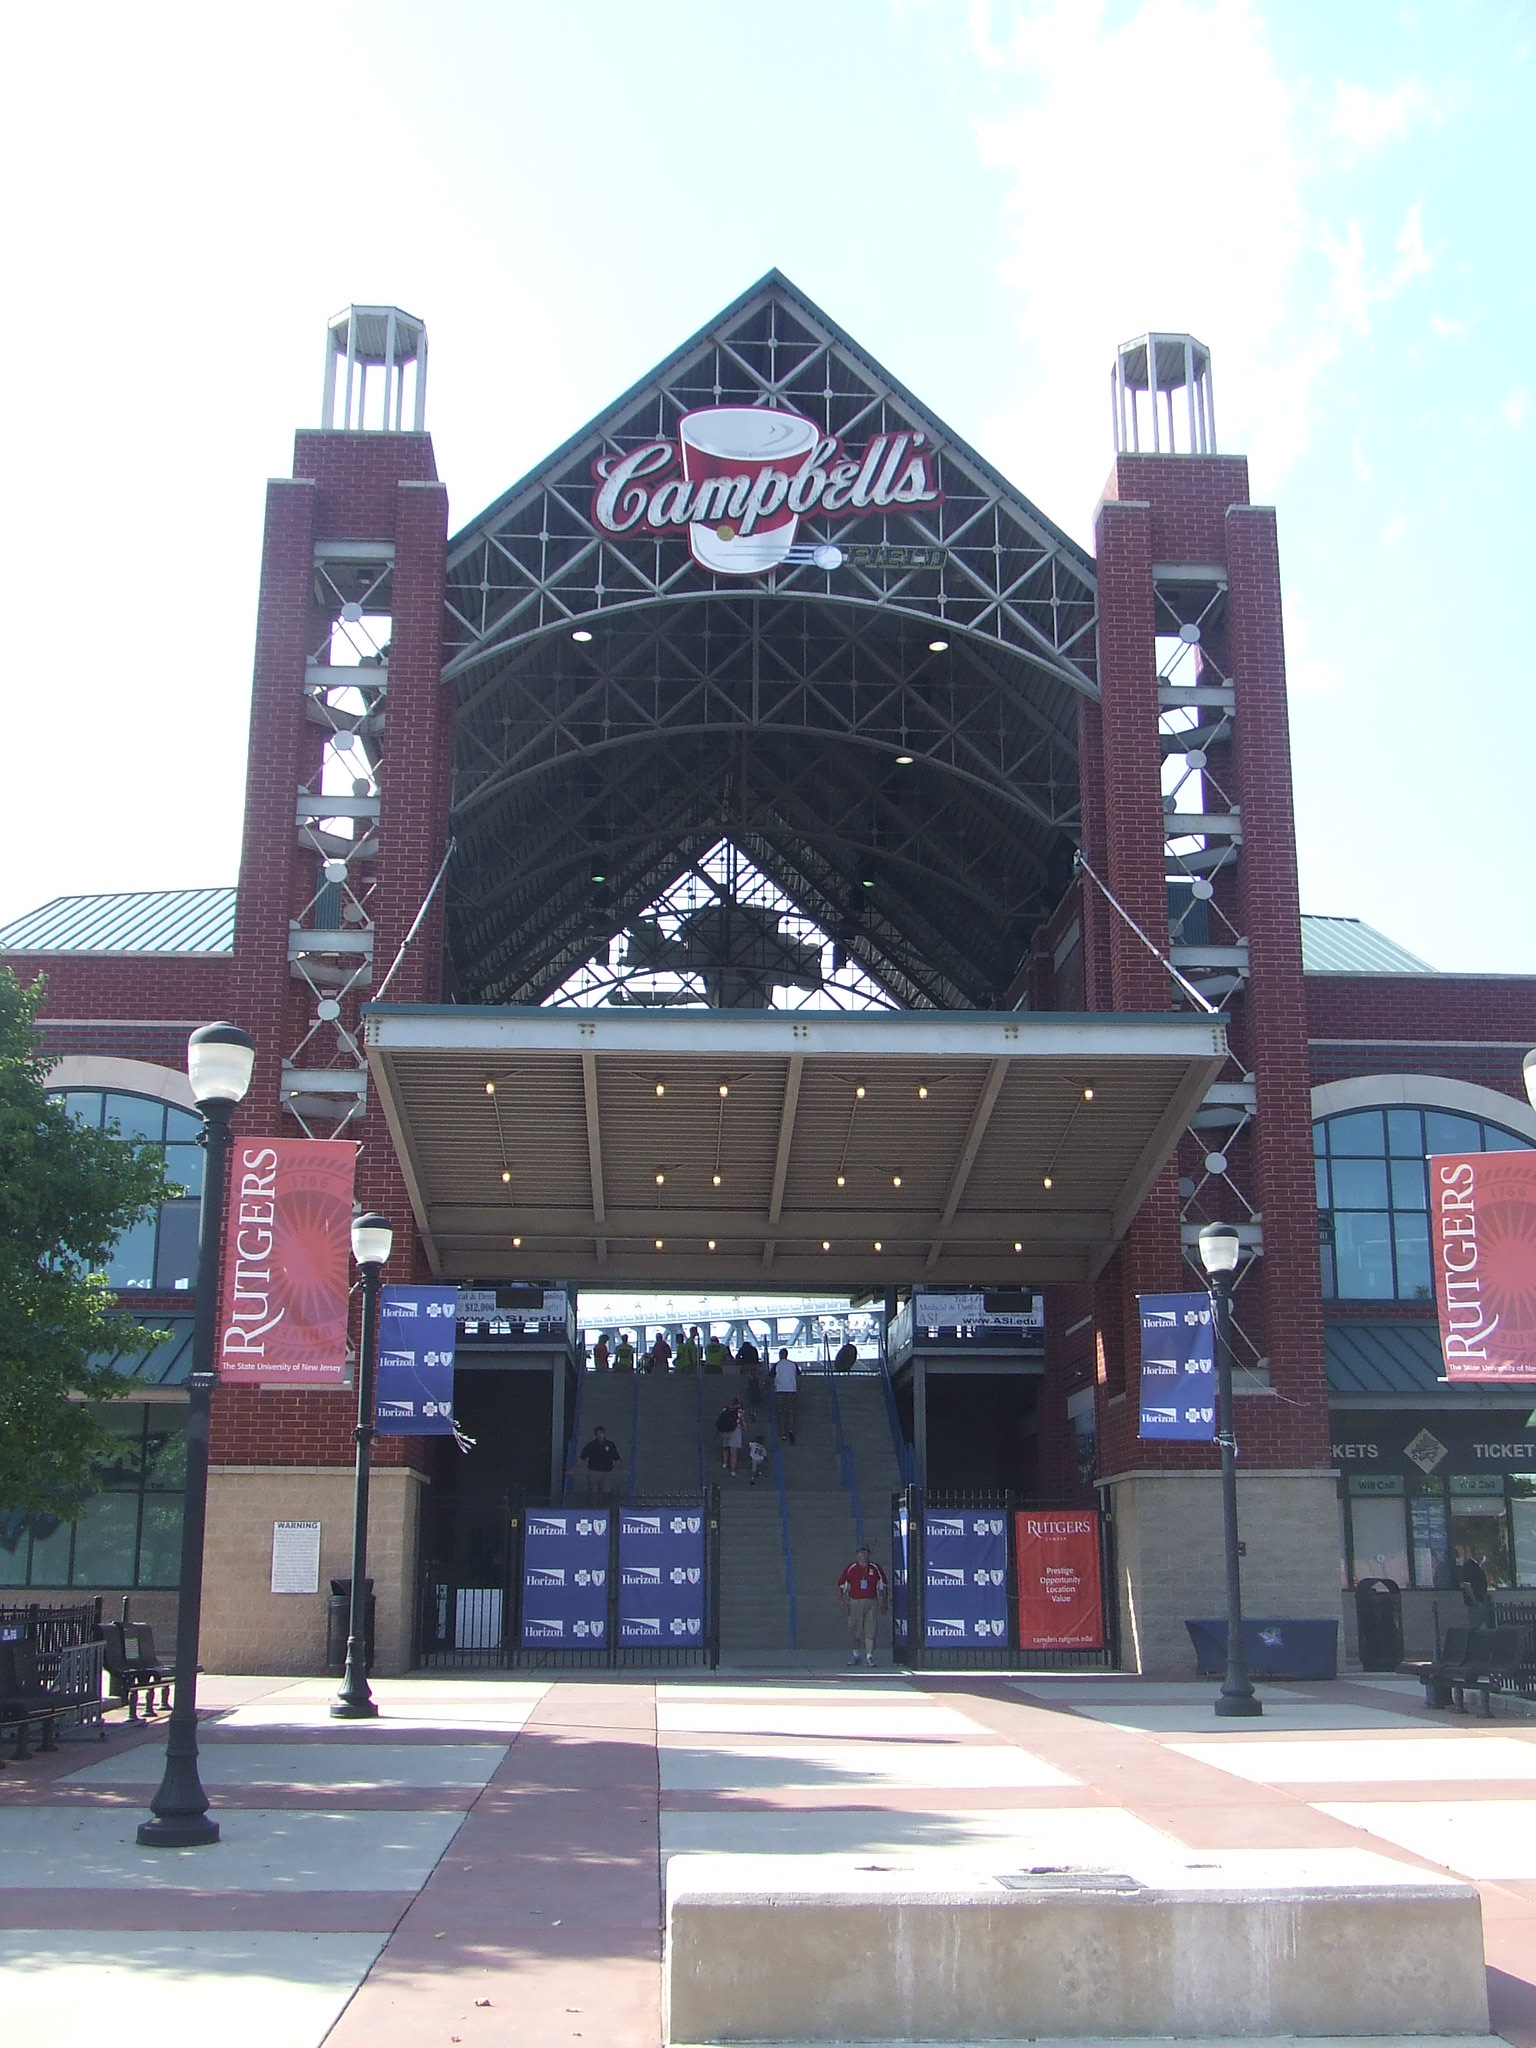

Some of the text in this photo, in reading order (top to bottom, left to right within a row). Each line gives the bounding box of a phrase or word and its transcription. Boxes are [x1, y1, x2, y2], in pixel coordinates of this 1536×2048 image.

[595, 432, 938, 537] Campbell's
[847, 546, 949, 569] FIELD
[222, 1148, 285, 1358] RUTGERS
[1441, 1163, 1499, 1361] RUTGERS
[382, 1308, 418, 1317] Horizon
[962, 1316, 1038, 1325] www.ASI.edu
[1143, 1318, 1177, 1328] Horizon
[223, 1362, 341, 1373] The State University of New Jersey
[379, 1357, 415, 1367] Horizon
[1449, 1363, 1461, 1371] The
[1142, 1366, 1177, 1375] Horizon
[378, 1408, 414, 1417] Horizon
[1142, 1414, 1177, 1423] Horizon
[1329, 1443, 1379, 1458] KETS
[1473, 1443, 1536, 1458] TICKET
[1358, 1481, 1395, 1490] Will Call
[528, 1525, 567, 1535] Horizon
[622, 1523, 661, 1534] Horizon
[926, 1525, 964, 1536] Horizon
[1027, 1520, 1091, 1539] RUTGERS
[1046, 1567, 1074, 1576] Prestige
[526, 1575, 565, 1586] Horizon
[622, 1574, 661, 1585] Horizon
[926, 1575, 965, 1586] Horizon
[1040, 1577, 1081, 1585] Opportunity
[1046, 1585, 1076, 1593] Location
[525, 1626, 564, 1637] Horizon
[621, 1625, 661, 1636] Horizon
[927, 1626, 965, 1637] Horizon
